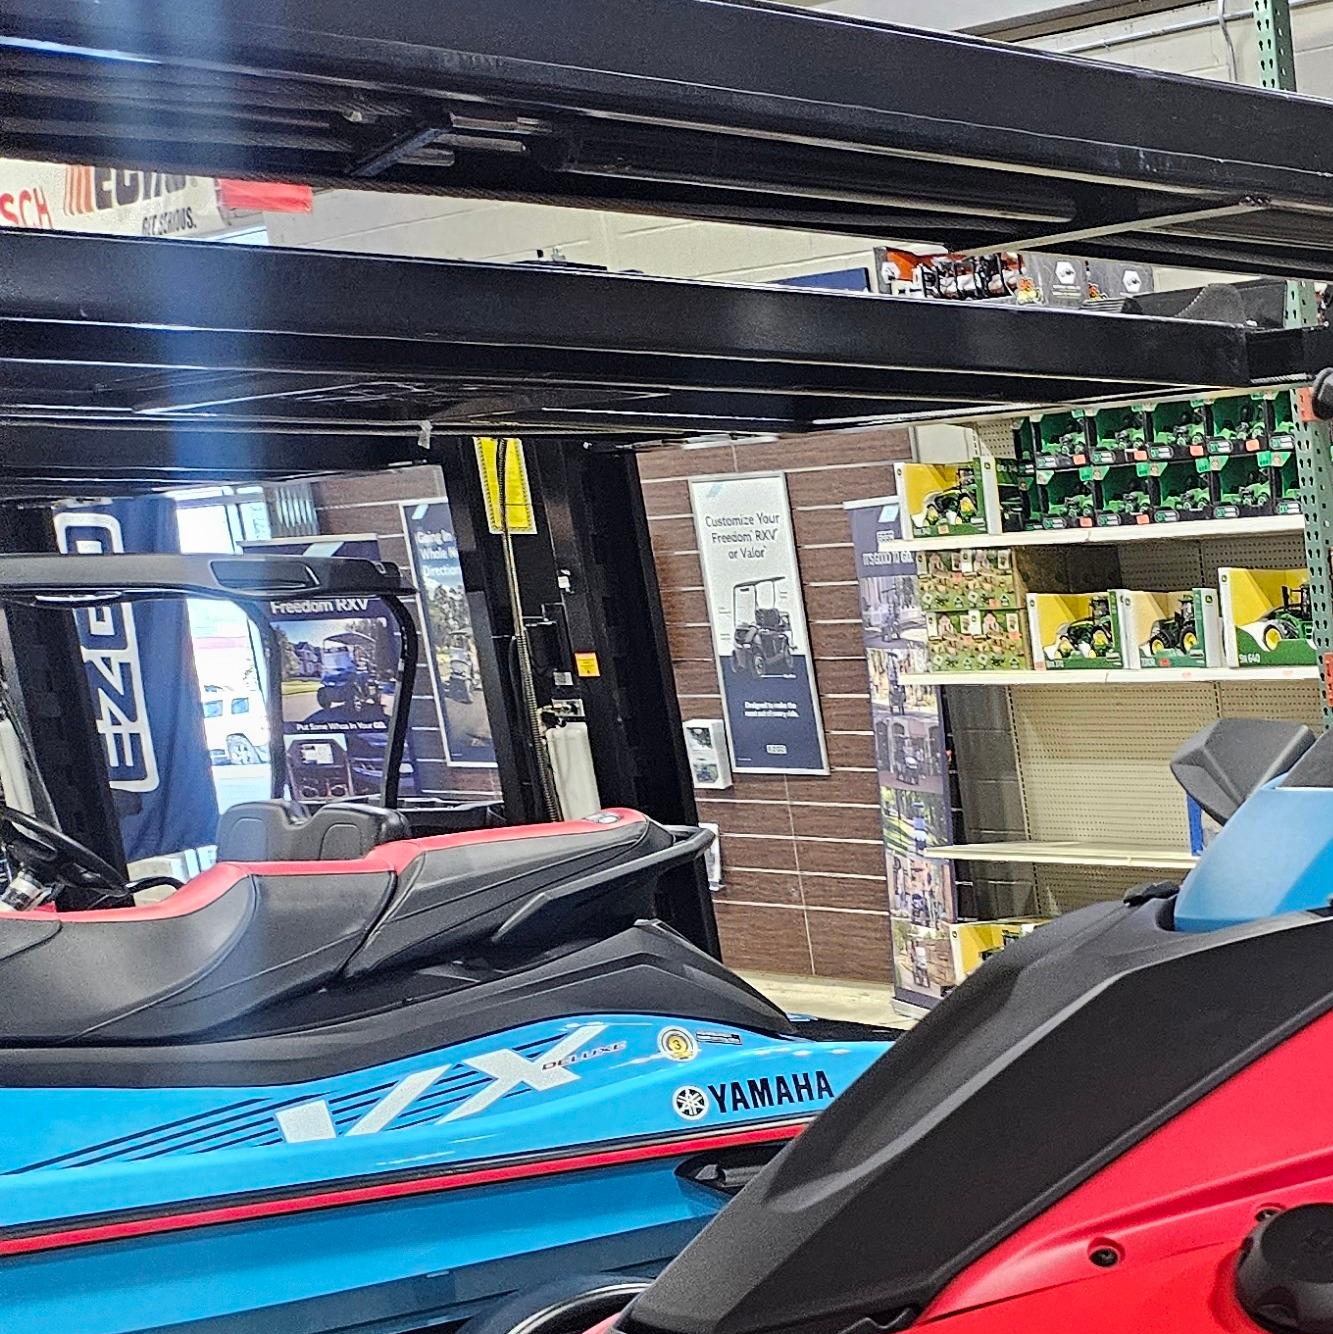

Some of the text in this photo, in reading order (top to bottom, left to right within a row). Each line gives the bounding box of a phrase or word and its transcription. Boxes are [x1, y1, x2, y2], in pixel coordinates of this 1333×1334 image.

[705, 512, 780, 528] Customize Your
[711, 531, 752, 544] Freedom
[728, 550, 738, 559] or
[270, 598, 370, 614] Freedom RXV
[541, 1041, 627, 1070] DELUXE
[274, 1022, 609, 1145] VX
[708, 1070, 836, 1114] YAMAHA
